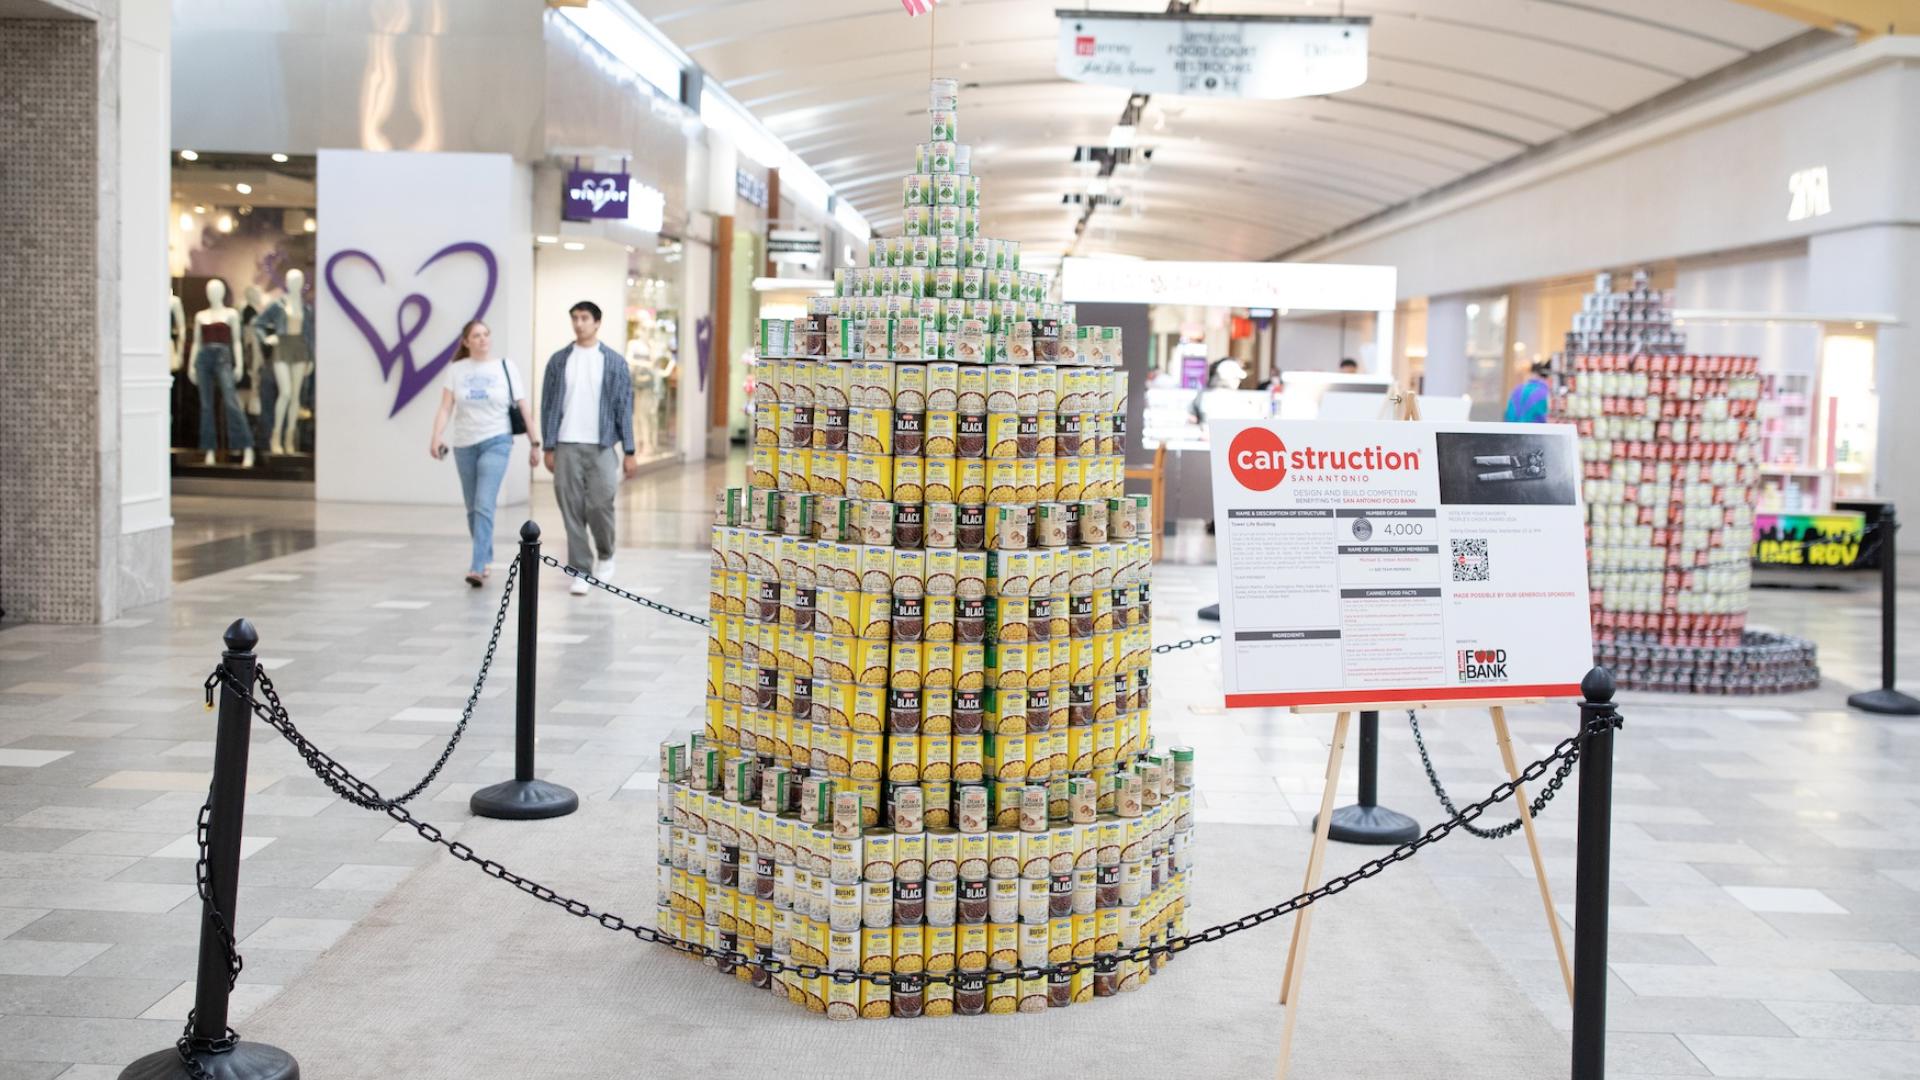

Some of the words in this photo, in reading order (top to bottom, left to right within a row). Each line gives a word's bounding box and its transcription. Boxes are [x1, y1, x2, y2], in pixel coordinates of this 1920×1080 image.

[898, 420, 918, 429] BLACK
[961, 422, 982, 432] BLACK
[1237, 446, 1420, 470] canstruction
[1294, 489, 1321, 497] DESIGN
[1324, 489, 1340, 497] AND
[1342, 489, 1365, 497] BUILD
[1367, 488, 1418, 497] COMPETITION
[899, 512, 920, 523] BLACK
[962, 514, 983, 524] BLACK
[1384, 523, 1423, 536] 4,000
[900, 606, 920, 615] BLACK
[1465, 649, 1507, 664] FOOD
[1466, 664, 1507, 678] BANK
[897, 698, 918, 707] BLACK
[958, 699, 979, 708] BLACK
[901, 889, 922, 899] BLACK
[966, 888, 987, 898] BLACK
